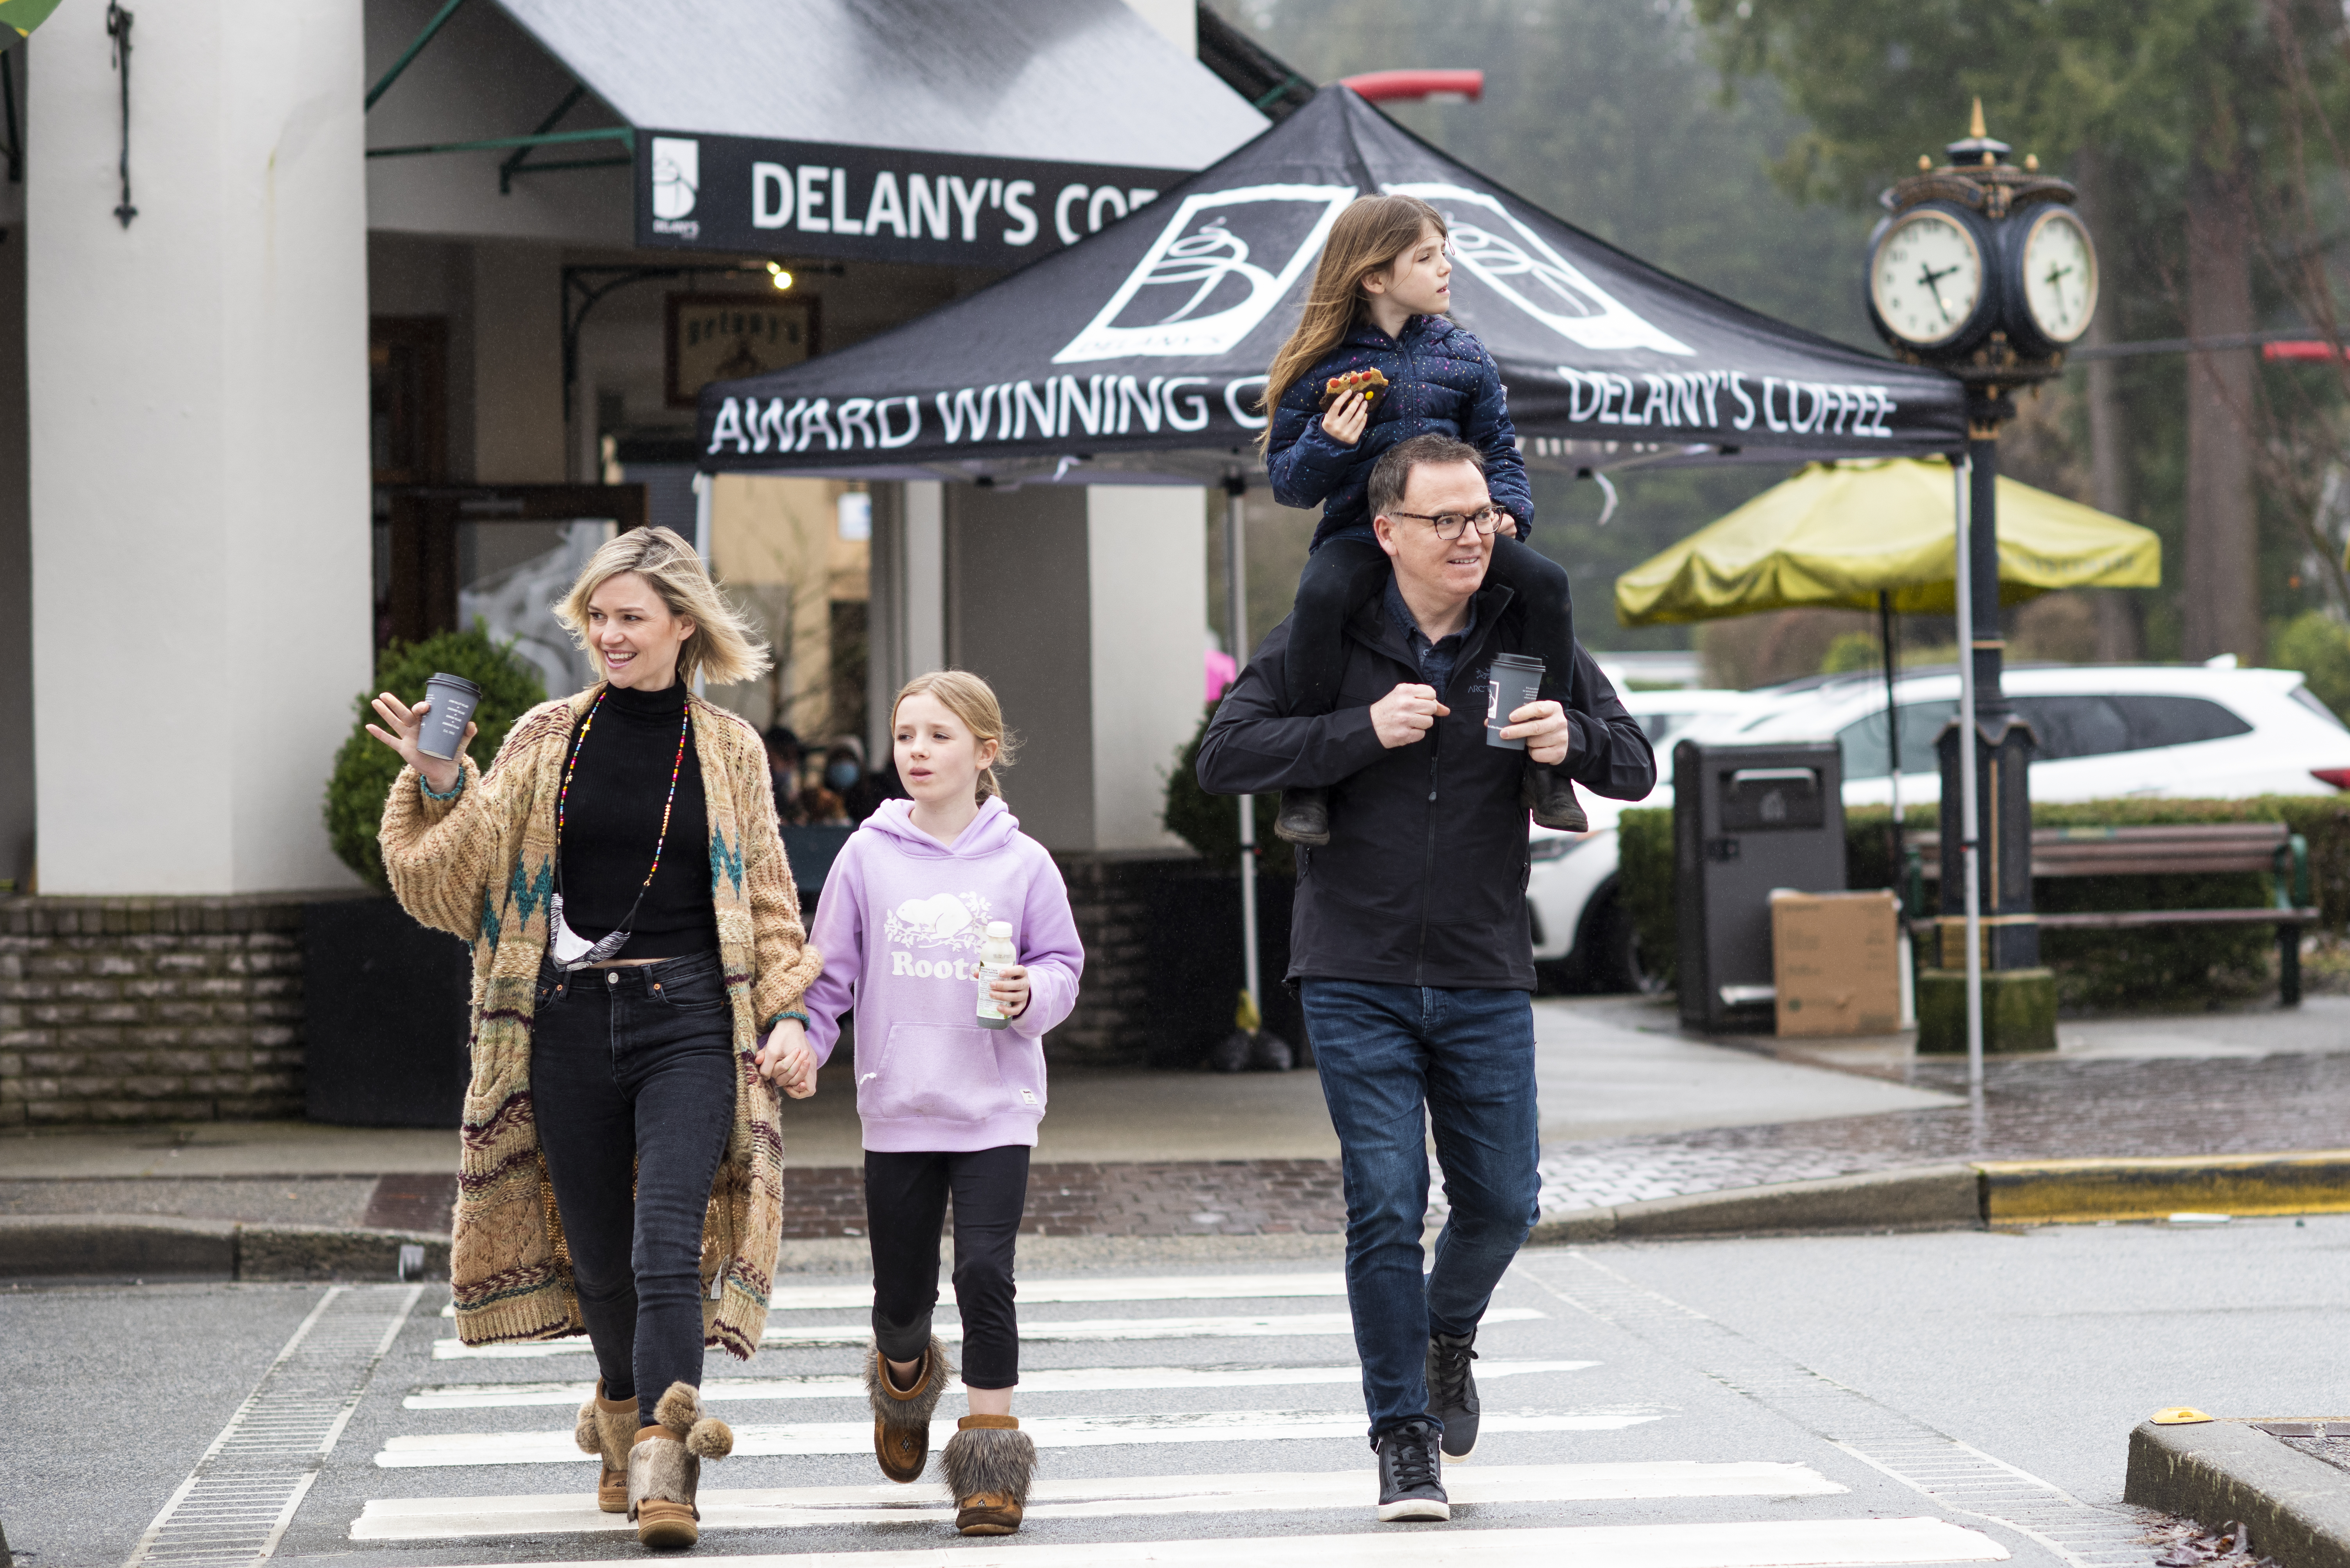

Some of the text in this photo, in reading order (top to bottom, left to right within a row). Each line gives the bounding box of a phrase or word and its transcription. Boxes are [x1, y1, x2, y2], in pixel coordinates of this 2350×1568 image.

[752, 161, 1158, 246] DELANY'S CO
[707, 396, 921, 454] AWARD
[936, 375, 1210, 443] WINNING
[1558, 366, 1897, 438] DELANY'S COFFEE
